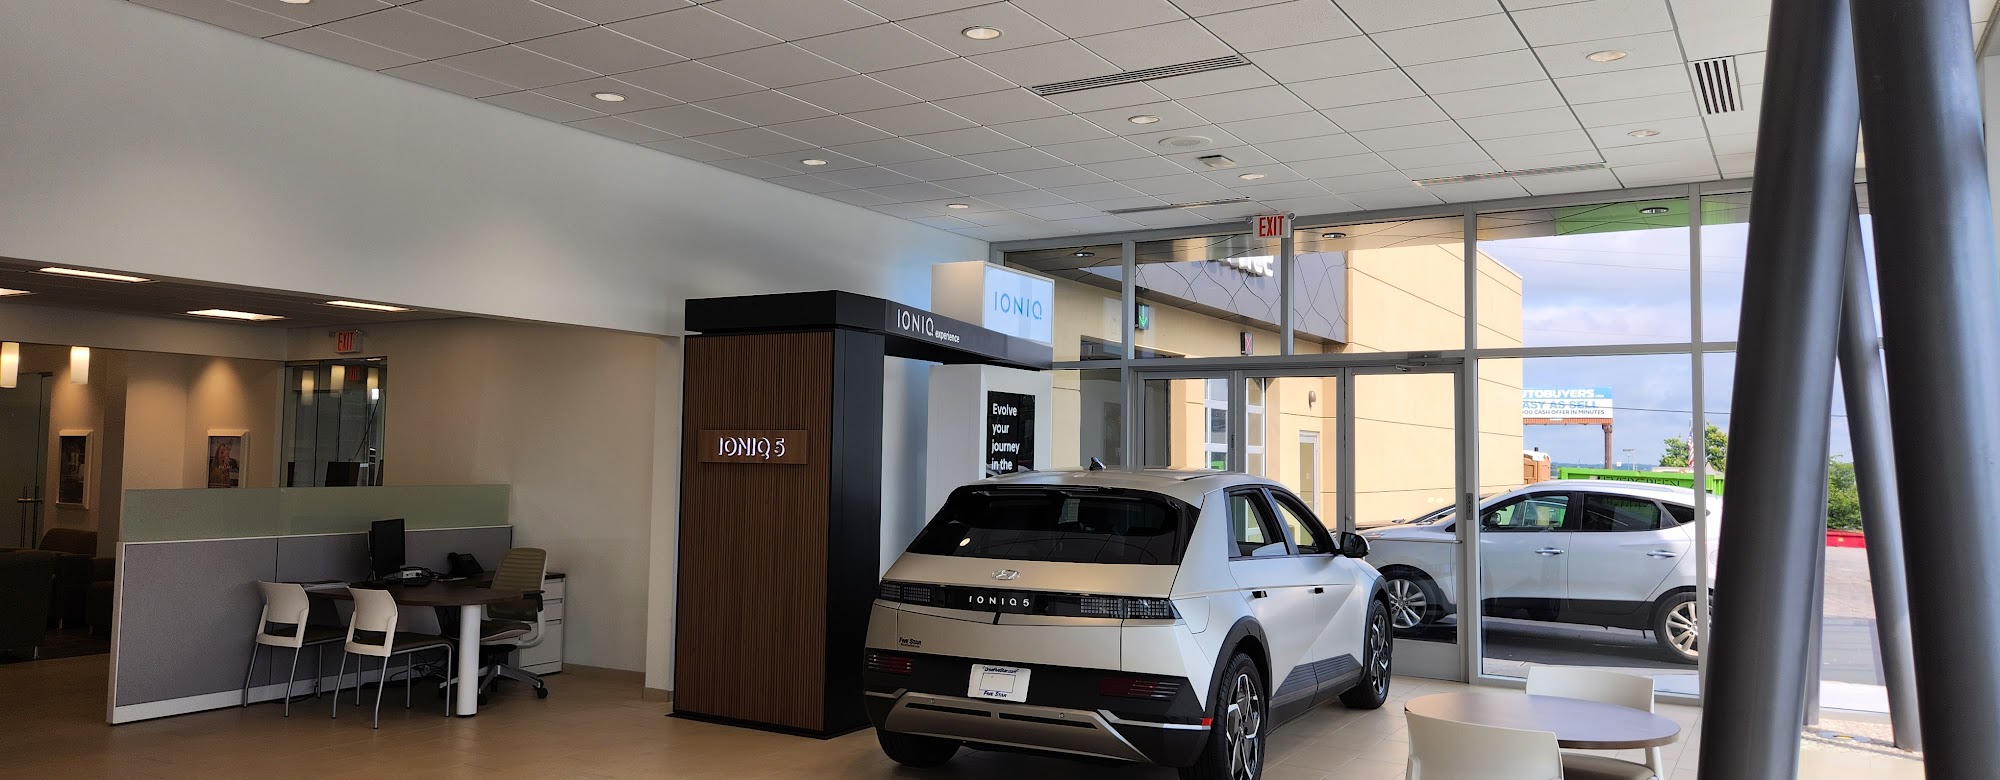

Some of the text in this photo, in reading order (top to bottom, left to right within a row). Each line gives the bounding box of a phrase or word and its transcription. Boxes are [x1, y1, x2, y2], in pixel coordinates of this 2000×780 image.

[1259, 216, 1284, 237] EXIT
[994, 291, 1042, 321] IONIQ
[897, 308, 960, 344] IONIQ experience
[337, 331, 354, 351] EXIT
[992, 403, 1018, 417] Evolve
[992, 424, 1010, 436] your
[718, 437, 786, 460] IONIQ 5
[991, 438, 1020, 455] journey
[991, 457, 1013, 471] in the
[968, 595, 1030, 607] IONIQ 5
